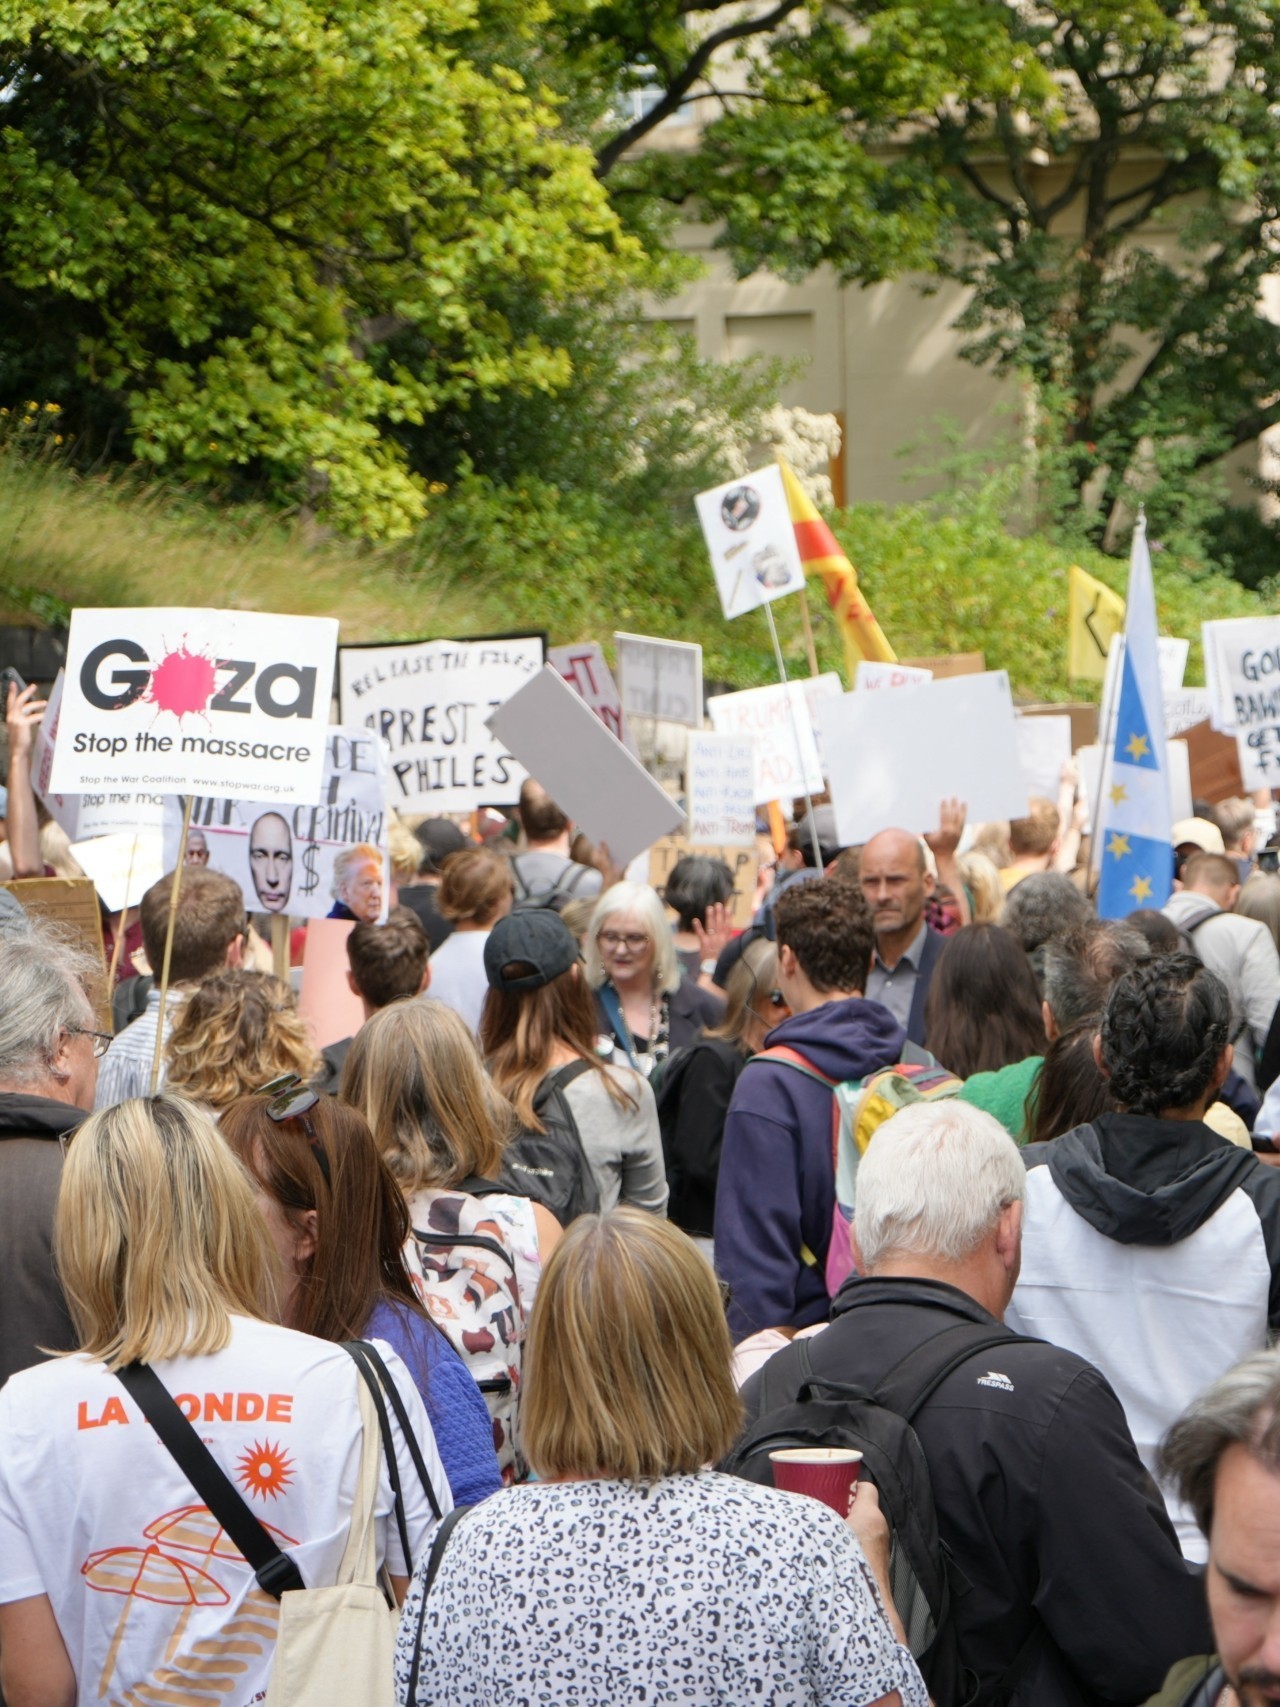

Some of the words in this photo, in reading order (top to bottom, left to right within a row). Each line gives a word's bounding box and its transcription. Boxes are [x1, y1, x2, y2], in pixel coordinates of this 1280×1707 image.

[351, 652, 434, 698] RELEASE
[73, 733, 127, 756] Stop
[136, 732, 173, 753] the
[181, 734, 310, 762] massacre
[80, 776, 100, 785] Stop
[103, 775, 119, 784] the
[121, 776, 139, 784] War
[142, 775, 187, 784] Coalition
[193, 778, 295, 794] www.stopwar.org.uk
[976, 1377, 1015, 1391] TRESPASS
[77, 1396, 129, 1431] LA
[144, 1392, 294, 1424] ONDE
